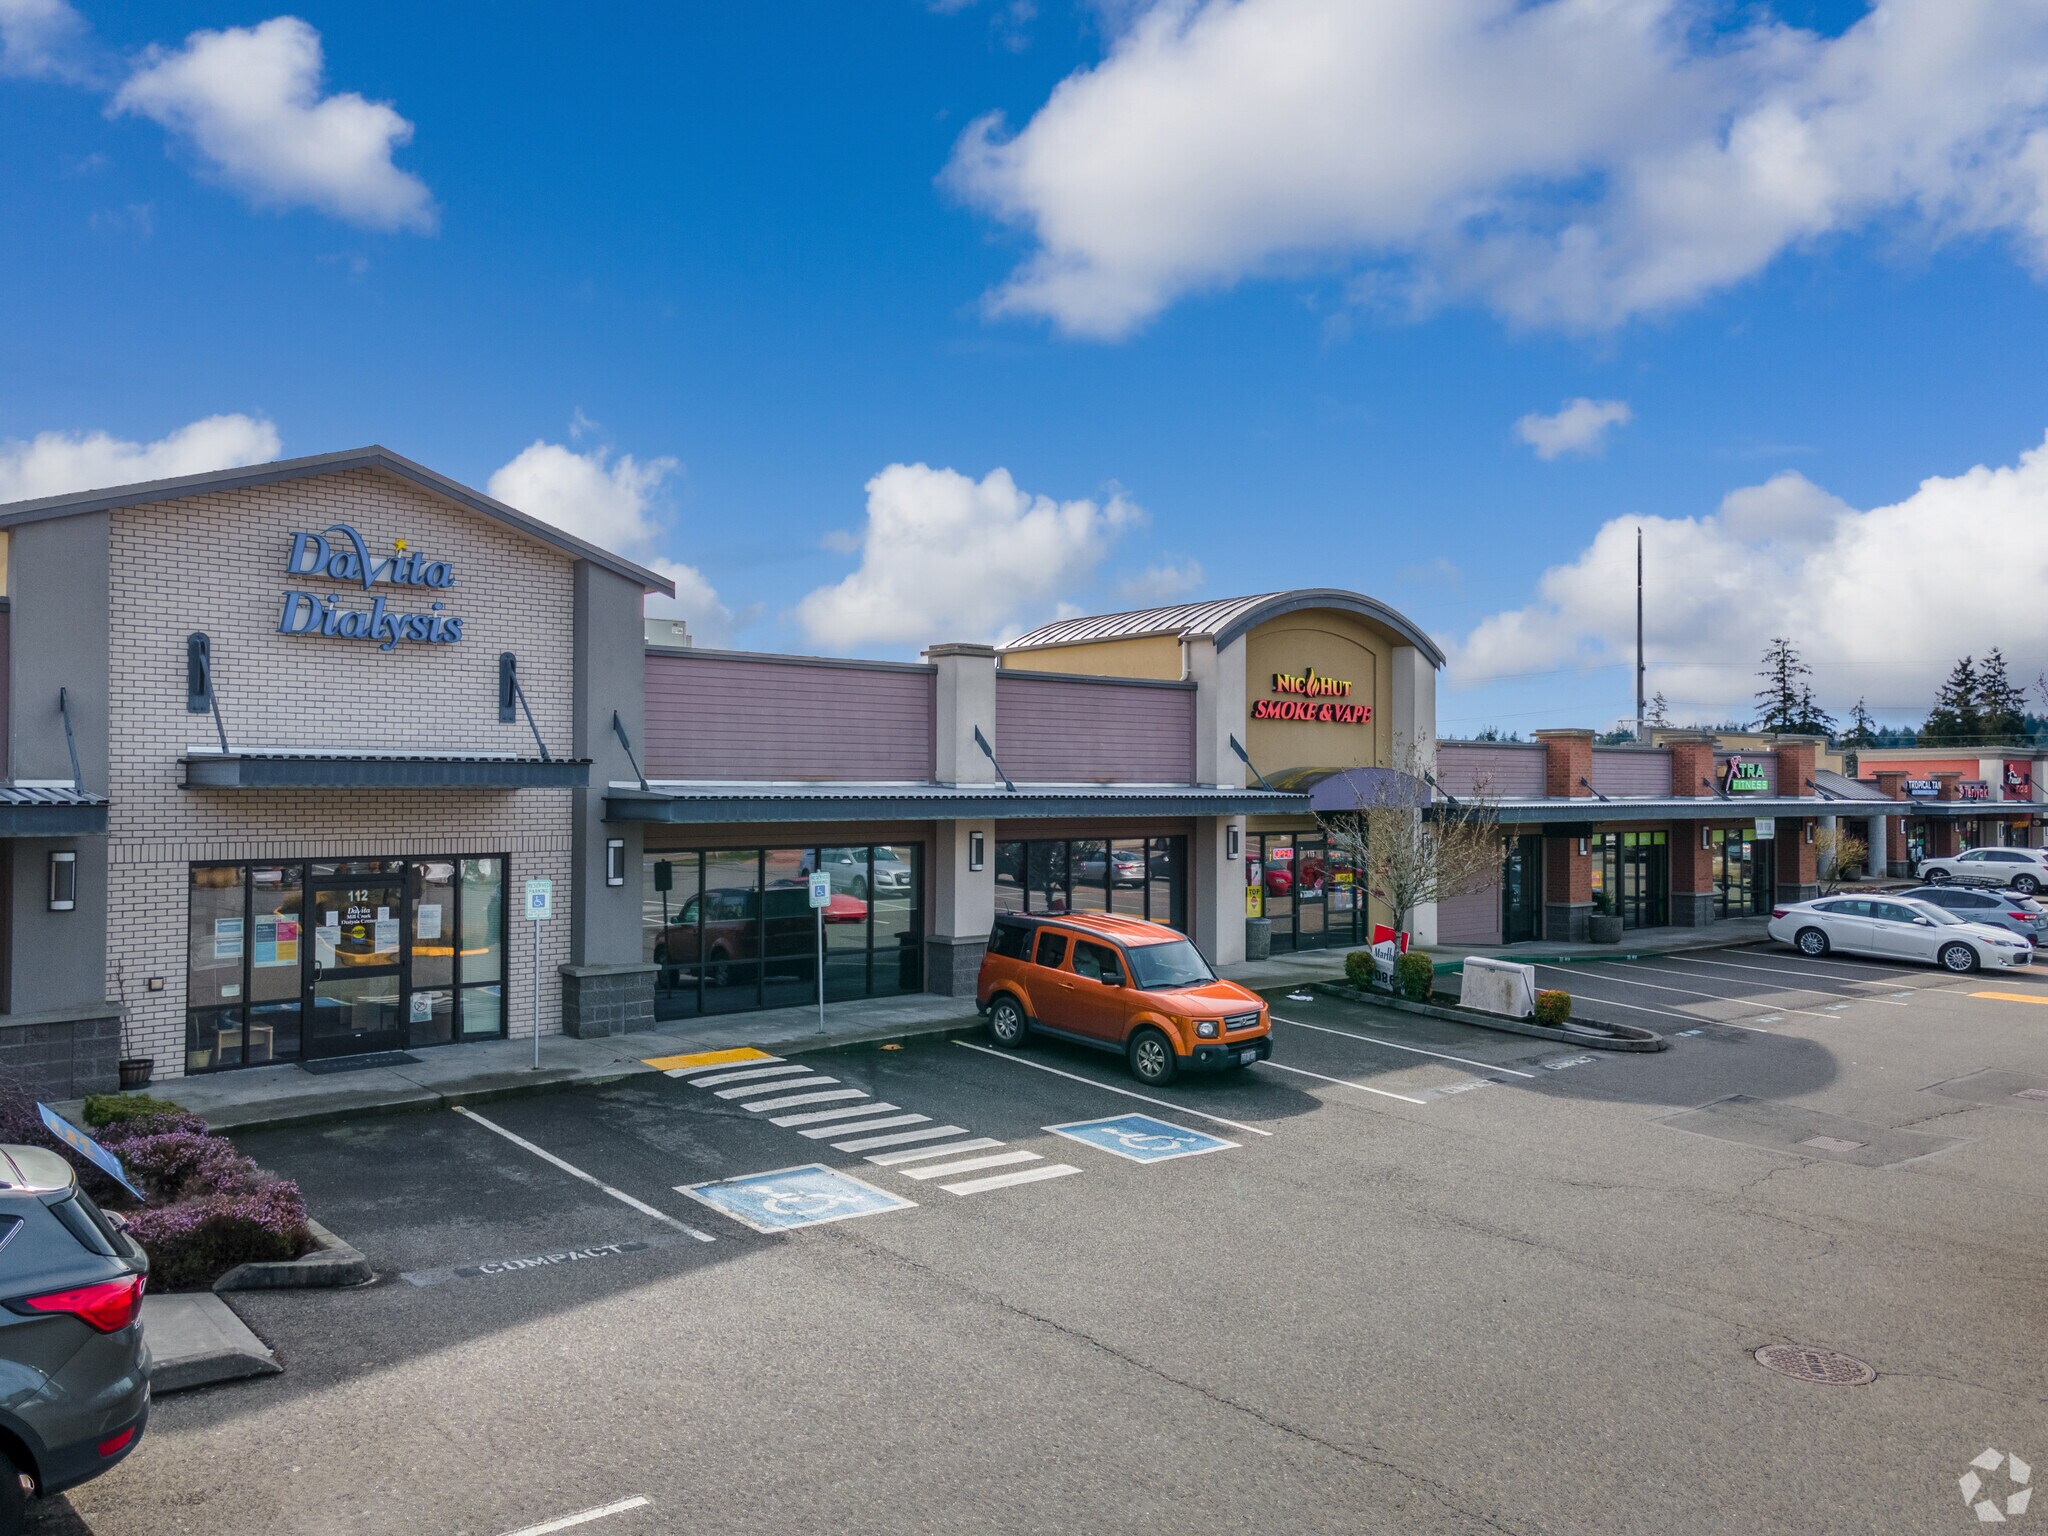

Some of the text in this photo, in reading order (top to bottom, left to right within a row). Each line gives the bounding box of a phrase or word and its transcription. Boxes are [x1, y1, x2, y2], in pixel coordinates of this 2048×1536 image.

[285, 524, 455, 590] DaVita
[276, 591, 463, 650] Dialysis
[1254, 700, 1372, 724] SMOKE & VAPE
[1733, 780, 1768, 790] FITNESS
[1909, 780, 1931, 790] TROPICAL
[1274, 849, 1293, 859] OPEN
[348, 890, 368, 902] 112
[1374, 947, 1394, 961] Marlb
[479, 1244, 622, 1274] COMPACT
